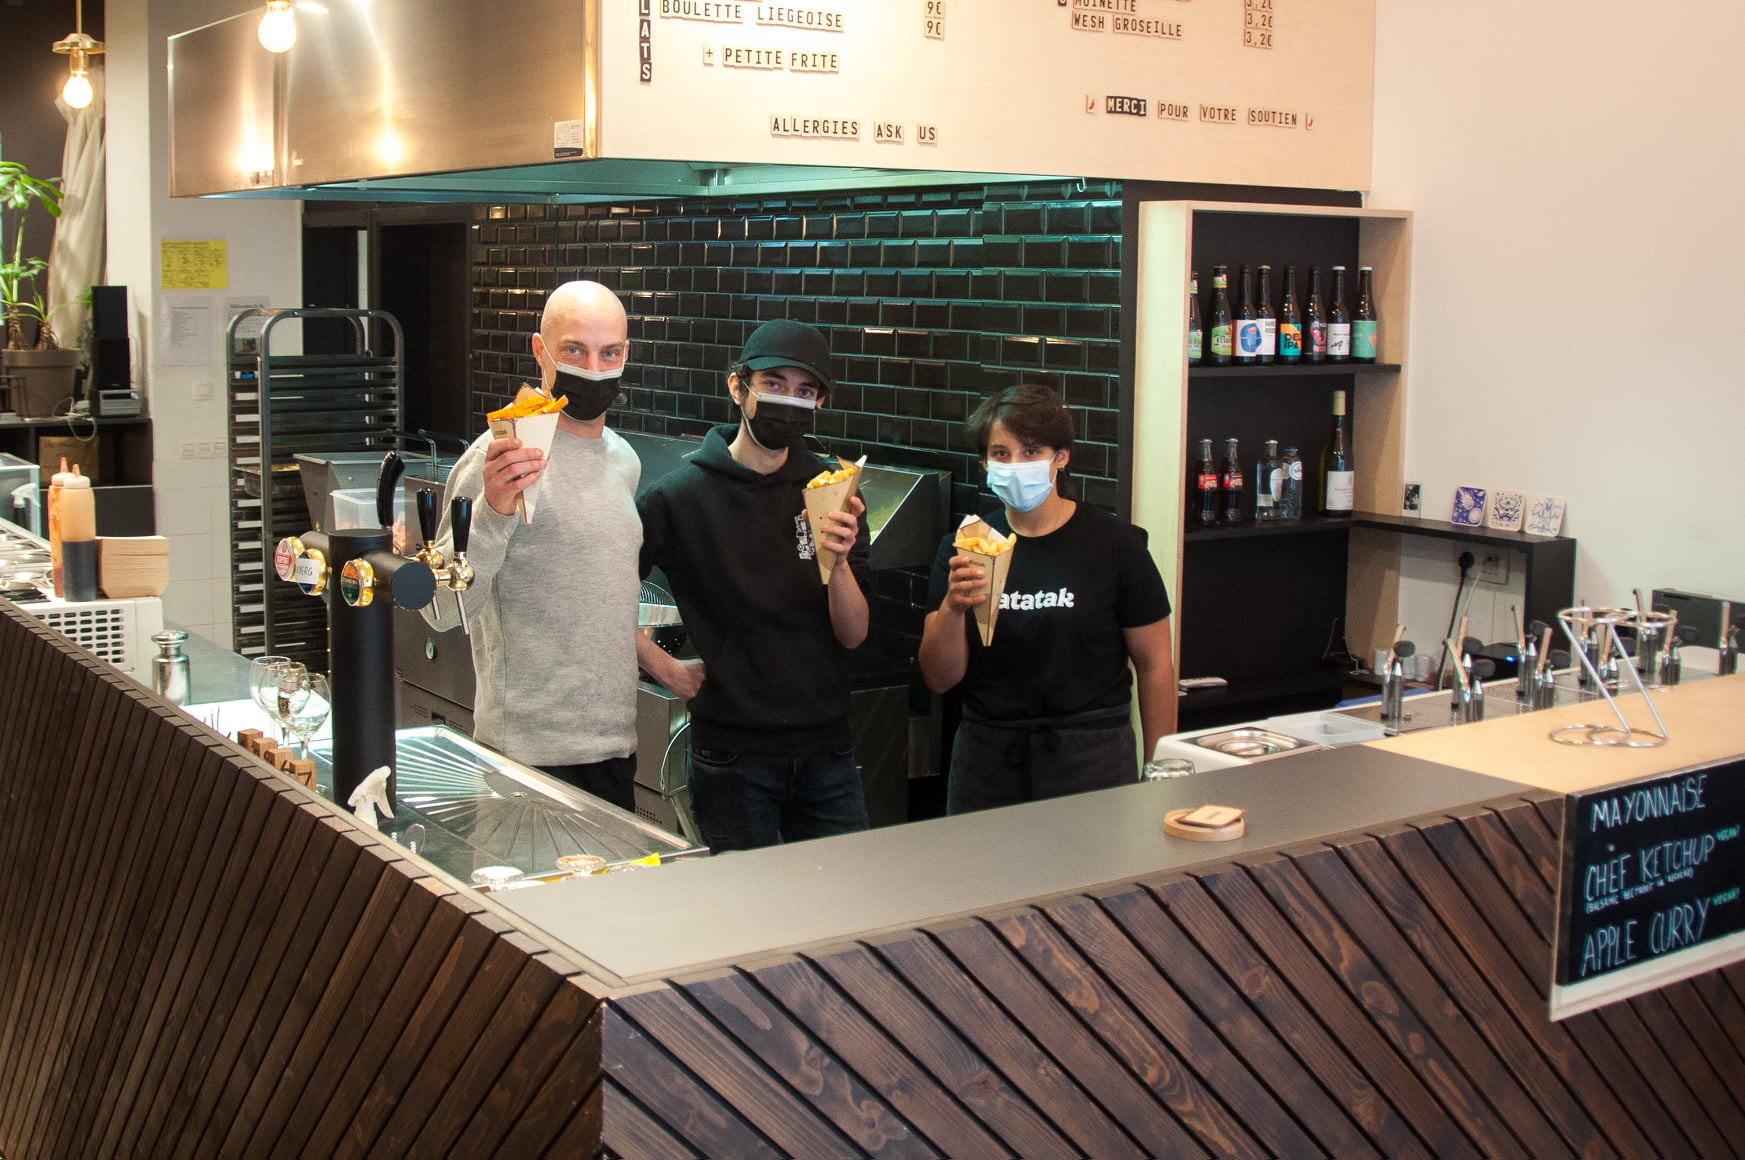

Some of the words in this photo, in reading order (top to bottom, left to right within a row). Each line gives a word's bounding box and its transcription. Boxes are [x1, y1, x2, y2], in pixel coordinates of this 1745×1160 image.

[662, 0, 741, 18] BOULETTE
[757, 6, 842, 28] LIEGEOISE
[927, 1, 942, 15] 9€
[1247, 12, 1273, 28] 3,2€
[926, 20, 942, 35] 9€
[1074, 13, 1105, 29] WESH
[1115, 17, 1182, 37] GROSEILLE
[640, 0, 651, 79] LATS
[1246, 31, 1272, 47] 3,2€
[725, 48, 782, 65] PETITE
[791, 53, 837, 68] FRITE
[1106, 97, 1147, 116] MERCI
[1160, 103, 1189, 118] POUR
[1202, 106, 1237, 121] VOTRE
[1250, 110, 1298, 126] SOUTIEN
[772, 117, 858, 135] ALLERGIES
[876, 124, 902, 138] ASK
[919, 126, 936, 141] US
[998, 587, 1075, 611] atatak
[1584, 854, 1632, 902] CHEF
[1641, 833, 1716, 882] KETCHUP
[1581, 919, 1638, 976] APPLE
[1652, 896, 1711, 955] CURRY
